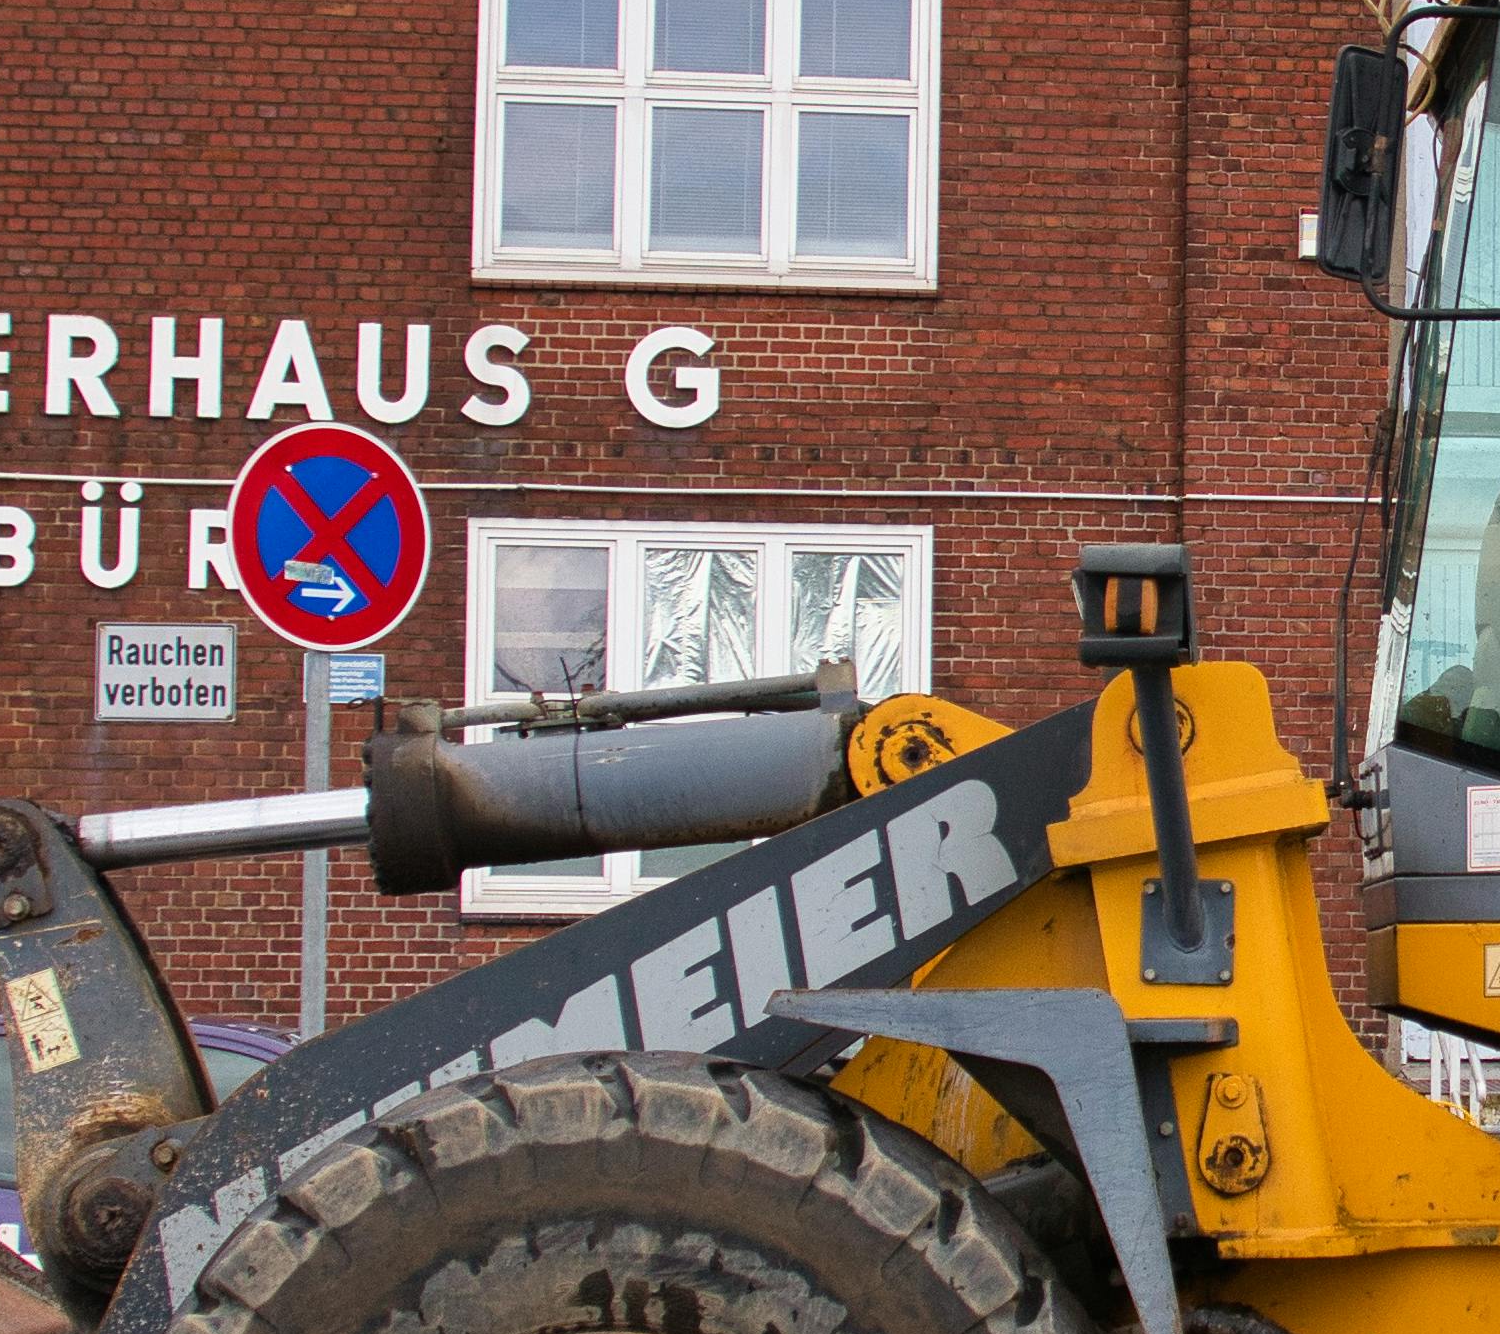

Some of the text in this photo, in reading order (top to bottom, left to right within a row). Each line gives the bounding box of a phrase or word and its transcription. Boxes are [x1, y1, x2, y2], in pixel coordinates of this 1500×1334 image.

[625, 326, 721, 429] G
[108, 634, 224, 667] Rauchen
[104, 676, 227, 707] verboten
